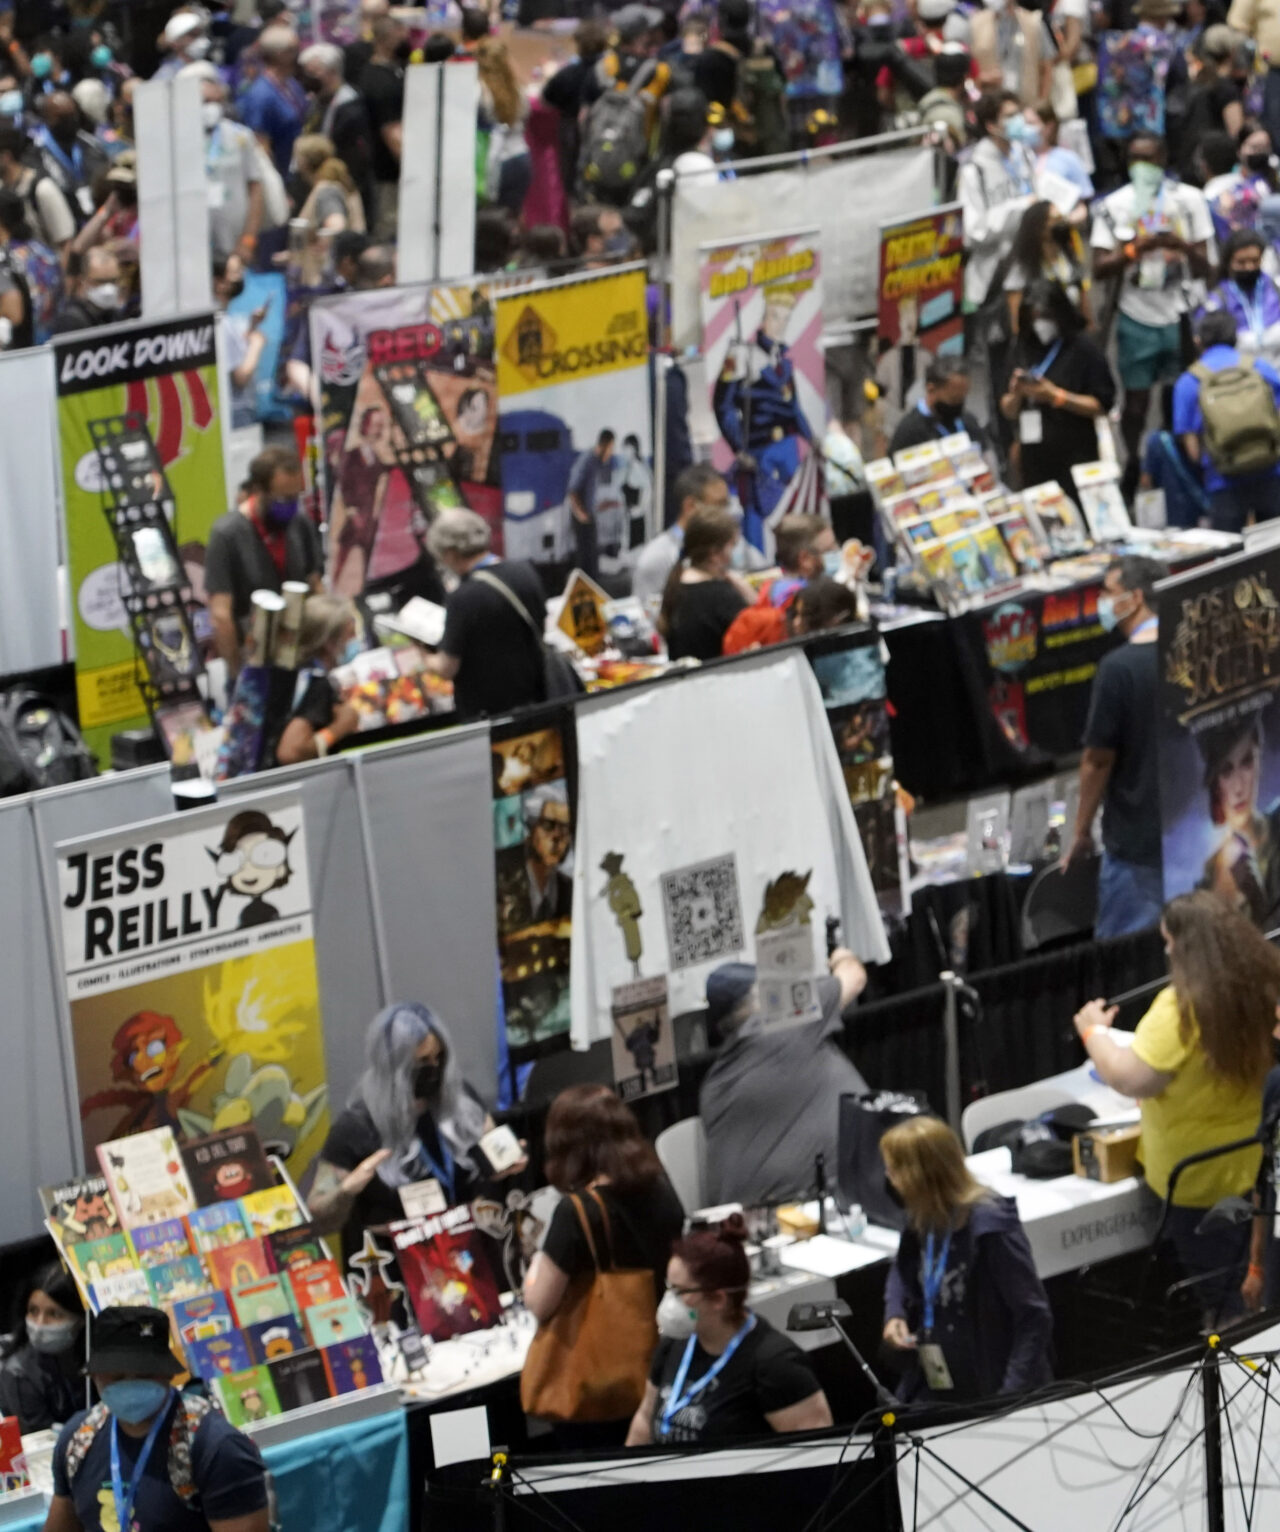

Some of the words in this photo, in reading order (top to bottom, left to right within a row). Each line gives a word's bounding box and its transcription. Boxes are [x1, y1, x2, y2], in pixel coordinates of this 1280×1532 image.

[60, 341, 131, 383] LOOK
[132, 325, 213, 368] DOWN!
[63, 842, 166, 908] JESS
[84, 884, 228, 963] REILLY
[78, 973, 111, 990] COMICS
[1061, 1207, 1148, 1250] EXPERGEFA
